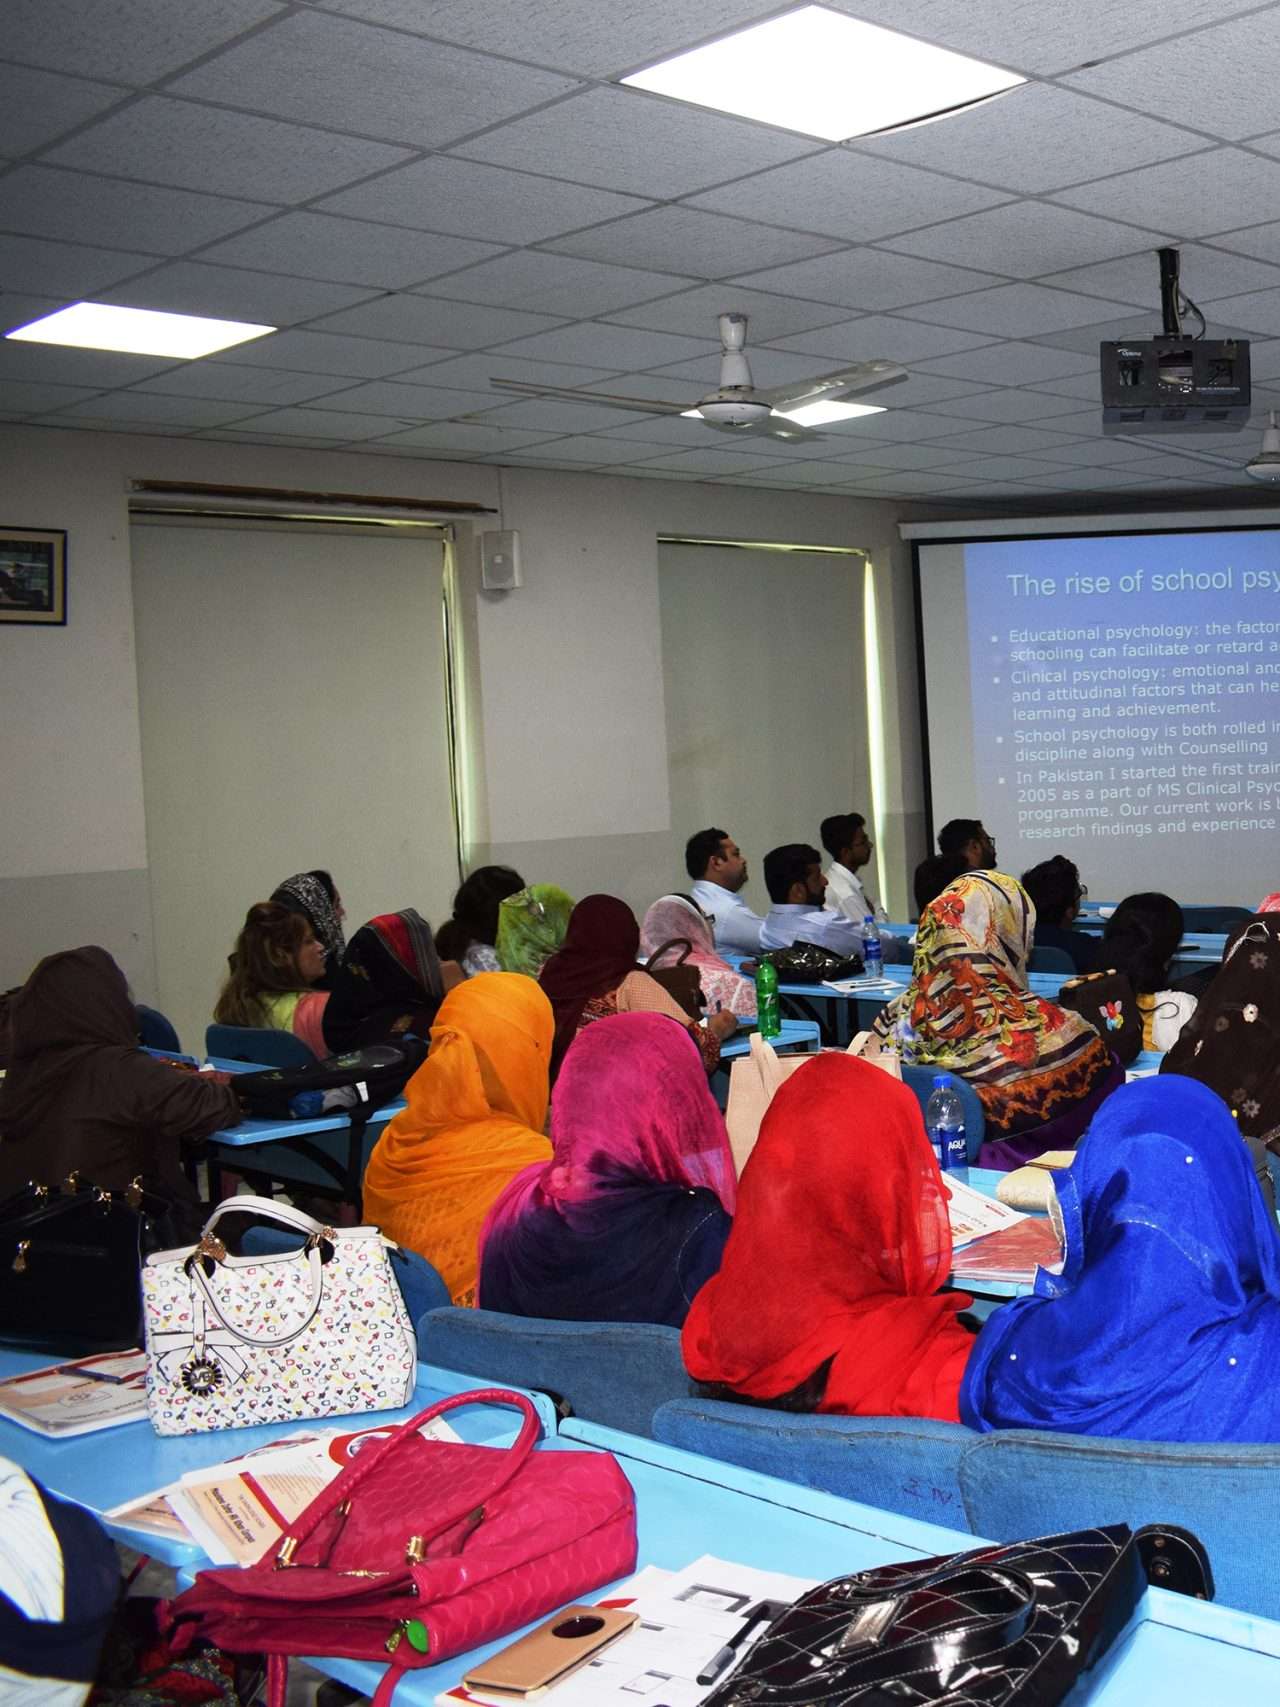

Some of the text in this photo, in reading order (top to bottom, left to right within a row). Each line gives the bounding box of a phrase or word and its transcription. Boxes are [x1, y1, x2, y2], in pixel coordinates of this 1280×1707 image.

[1006, 571, 1056, 596] The
[1065, 571, 1110, 594] rise
[1118, 568, 1143, 592] of
[1151, 565, 1232, 591] school
[1009, 625, 1100, 642] Educational
[1105, 622, 1198, 642] psychology:
[1205, 620, 1231, 635] the
[1010, 645, 1084, 662] schooling
[1089, 646, 1116, 658] can
[1122, 641, 1189, 657] facilitate
[1193, 643, 1211, 654] or
[1216, 637, 1263, 653] retard
[1010, 667, 1066, 684] Clinical
[1072, 665, 1165, 685] psychology:
[1172, 660, 1249, 678] emotional
[1011, 686, 1041, 702] and
[1047, 683, 1126, 700] attitudinal
[1131, 683, 1185, 697] factors
[1190, 680, 1222, 695] that
[1227, 682, 1255, 694] can
[1012, 699, 1221, 722] learning and achievement.
[1013, 727, 1066, 743] School
[1071, 724, 1159, 744] psychology
[1164, 723, 1177, 737] is
[1181, 720, 1217, 736] both
[1222, 718, 1266, 735] rolled
[1015, 738, 1268, 764] discipline along with Counselling
[1016, 769, 1032, 783] In
[1038, 767, 1103, 782] Pakistan
[1109, 765, 1115, 780] I
[1120, 763, 1176, 779] started
[1181, 762, 1207, 777] the
[1211, 761, 1243, 776] first
[1017, 786, 1057, 802] 2005
[1061, 789, 1080, 800] as
[1084, 788, 1094, 799] a
[1099, 784, 1131, 802] part
[1136, 782, 1152, 797] of
[1157, 781, 1181, 796] MS
[1185, 779, 1241, 795] Clinical
[1018, 806, 1113, 823] programme.
[1119, 801, 1148, 816] Our
[1153, 799, 1209, 815] current
[1215, 797, 1253, 812] work
[1258, 797, 1271, 811] is
[1018, 822, 1085, 839] research
[1090, 820, 1152, 837] findings
[1157, 818, 1186, 833] and
[1191, 816, 1276, 834] experience
